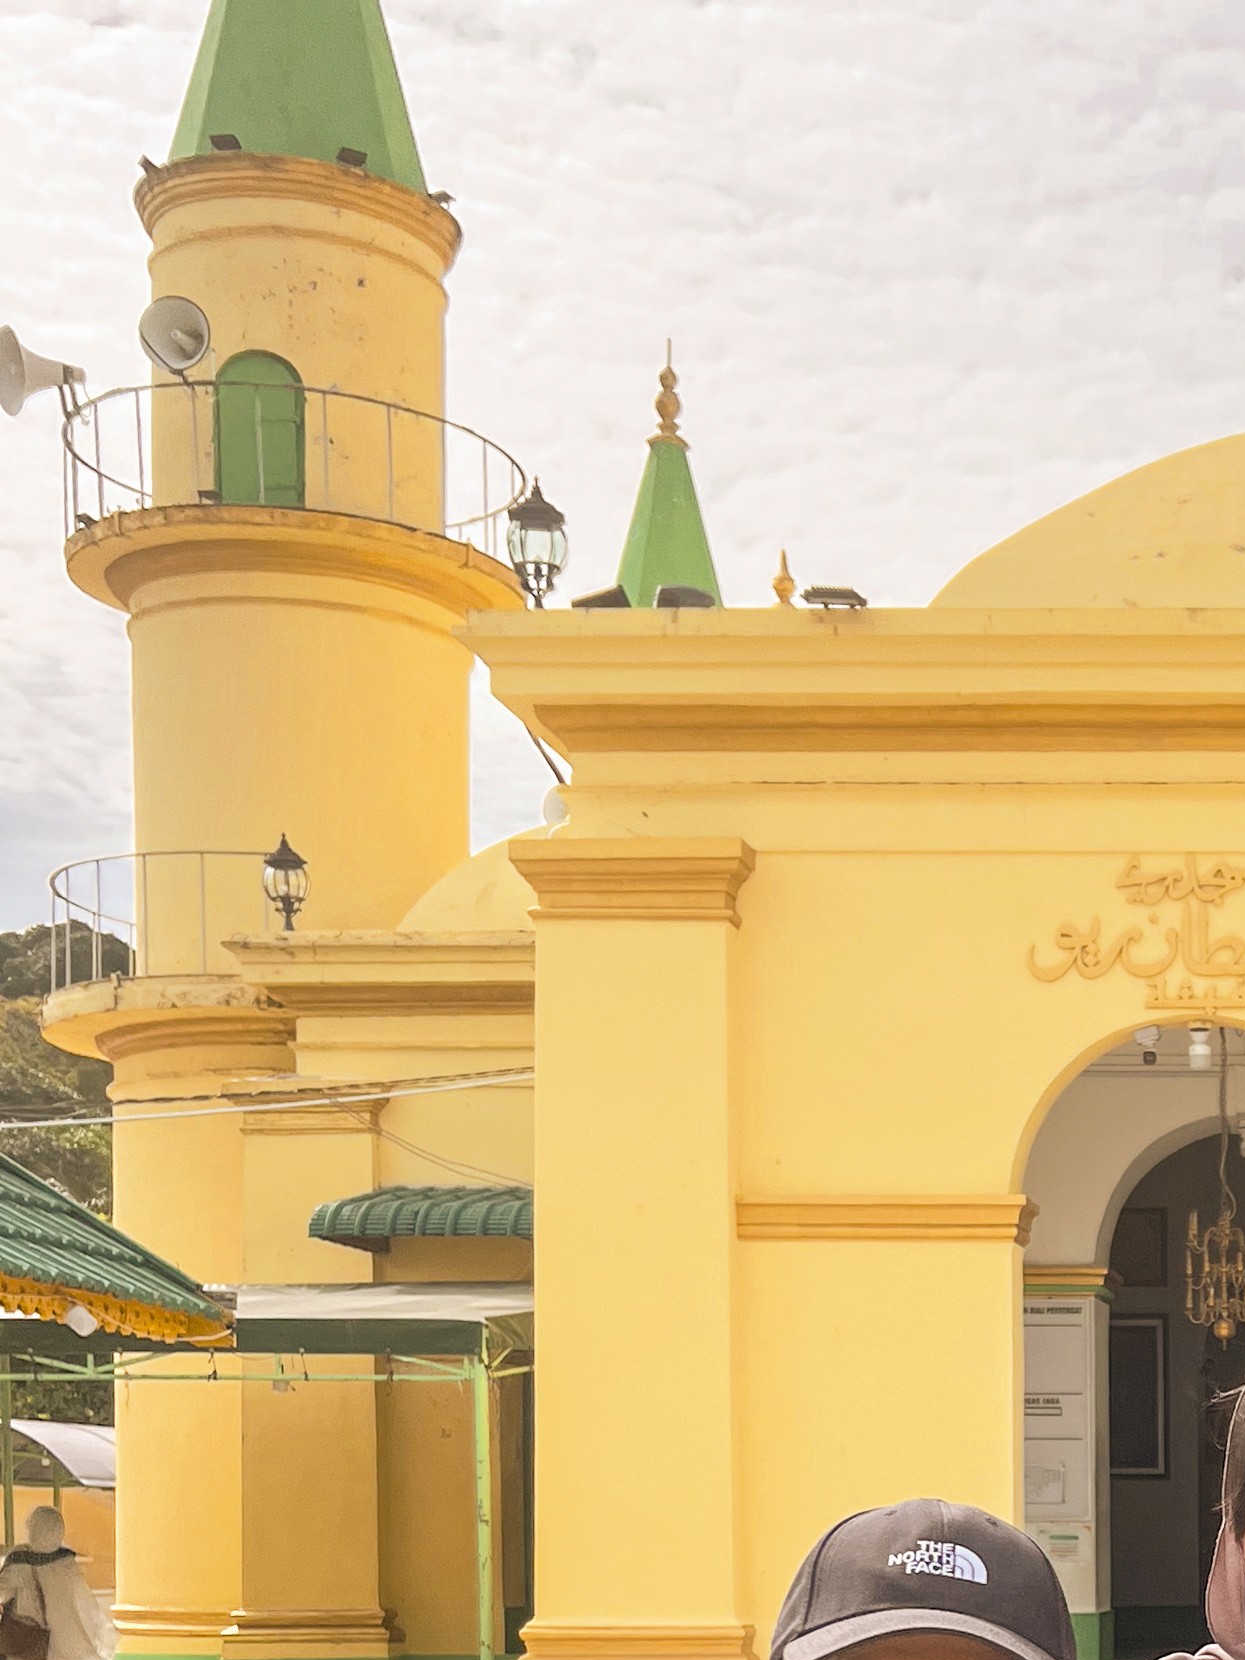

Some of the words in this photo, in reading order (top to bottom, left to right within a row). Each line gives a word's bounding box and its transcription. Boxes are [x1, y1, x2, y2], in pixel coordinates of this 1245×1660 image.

[917, 1540, 954, 1554] THE
[888, 1550, 954, 1567] NORTH
[905, 1562, 954, 1577] FACE
